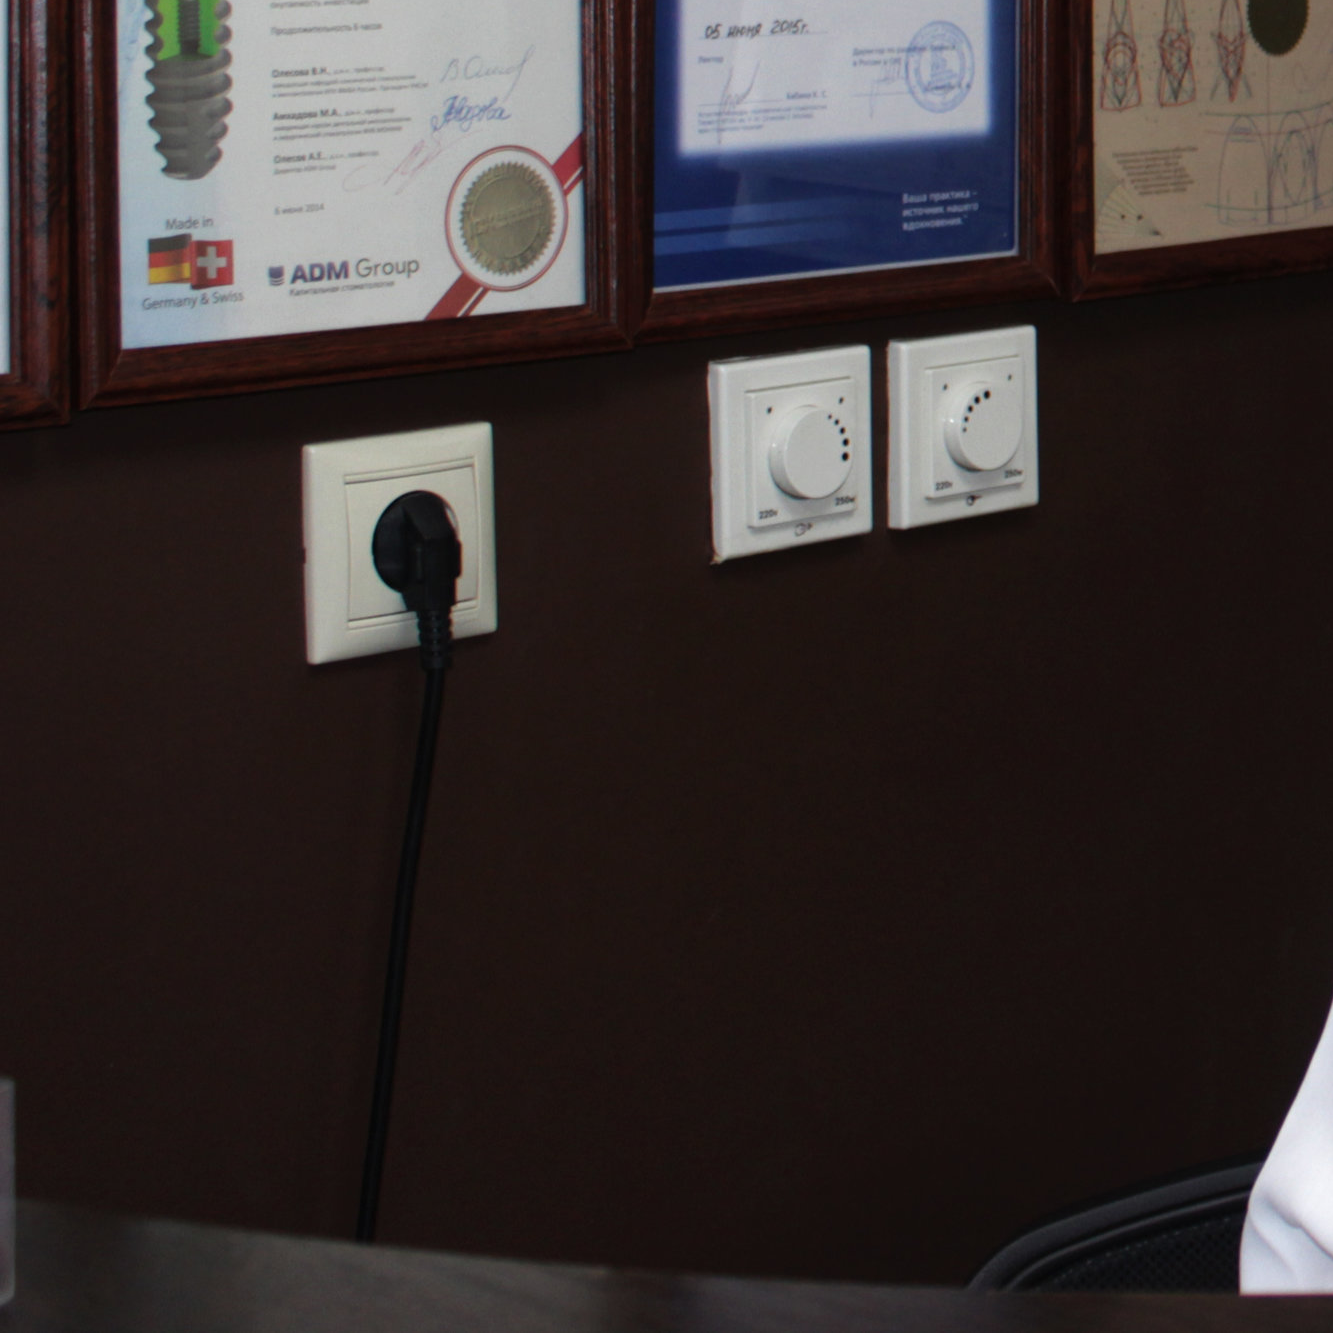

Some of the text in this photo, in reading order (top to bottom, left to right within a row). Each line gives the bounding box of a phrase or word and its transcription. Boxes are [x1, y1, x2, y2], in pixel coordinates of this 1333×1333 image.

[902, 191, 971, 204] Ваша практика
[165, 216, 214, 231] Made in
[289, 257, 421, 284] ADM Group
[141, 291, 244, 311] Germany & Swiss
